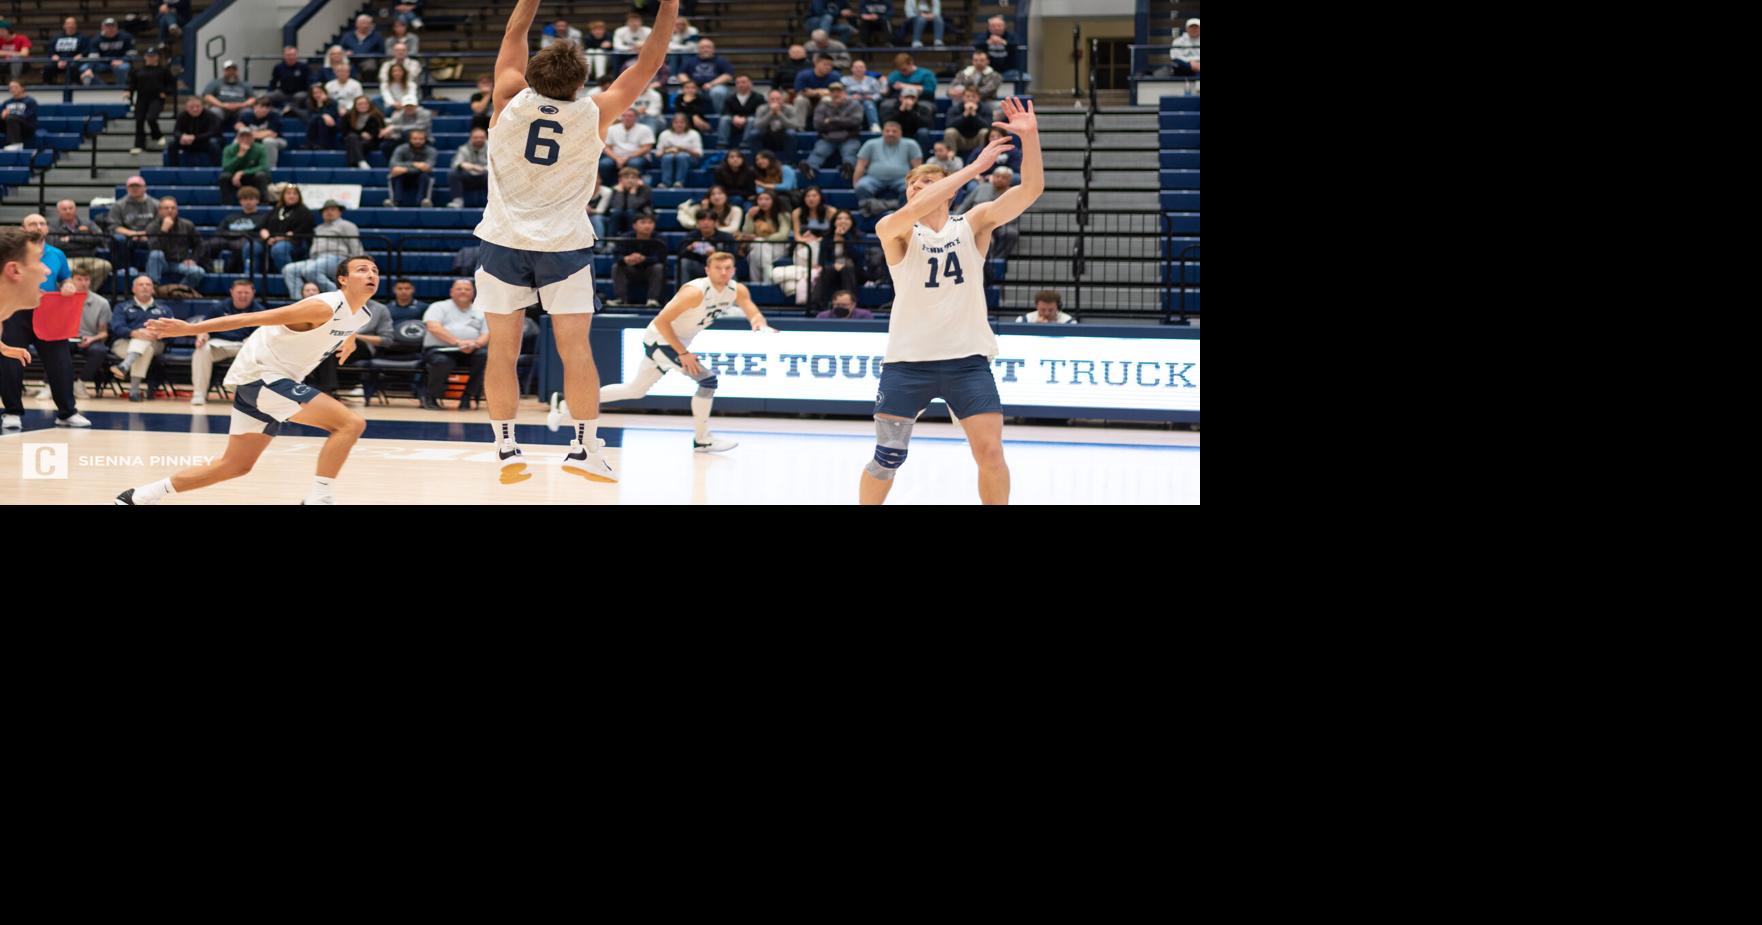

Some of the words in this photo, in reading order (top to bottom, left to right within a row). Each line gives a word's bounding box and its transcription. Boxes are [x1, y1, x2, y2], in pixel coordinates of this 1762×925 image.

[524, 118, 564, 166] 6
[925, 251, 964, 288] 14
[1040, 359, 1197, 387] TRUCK
